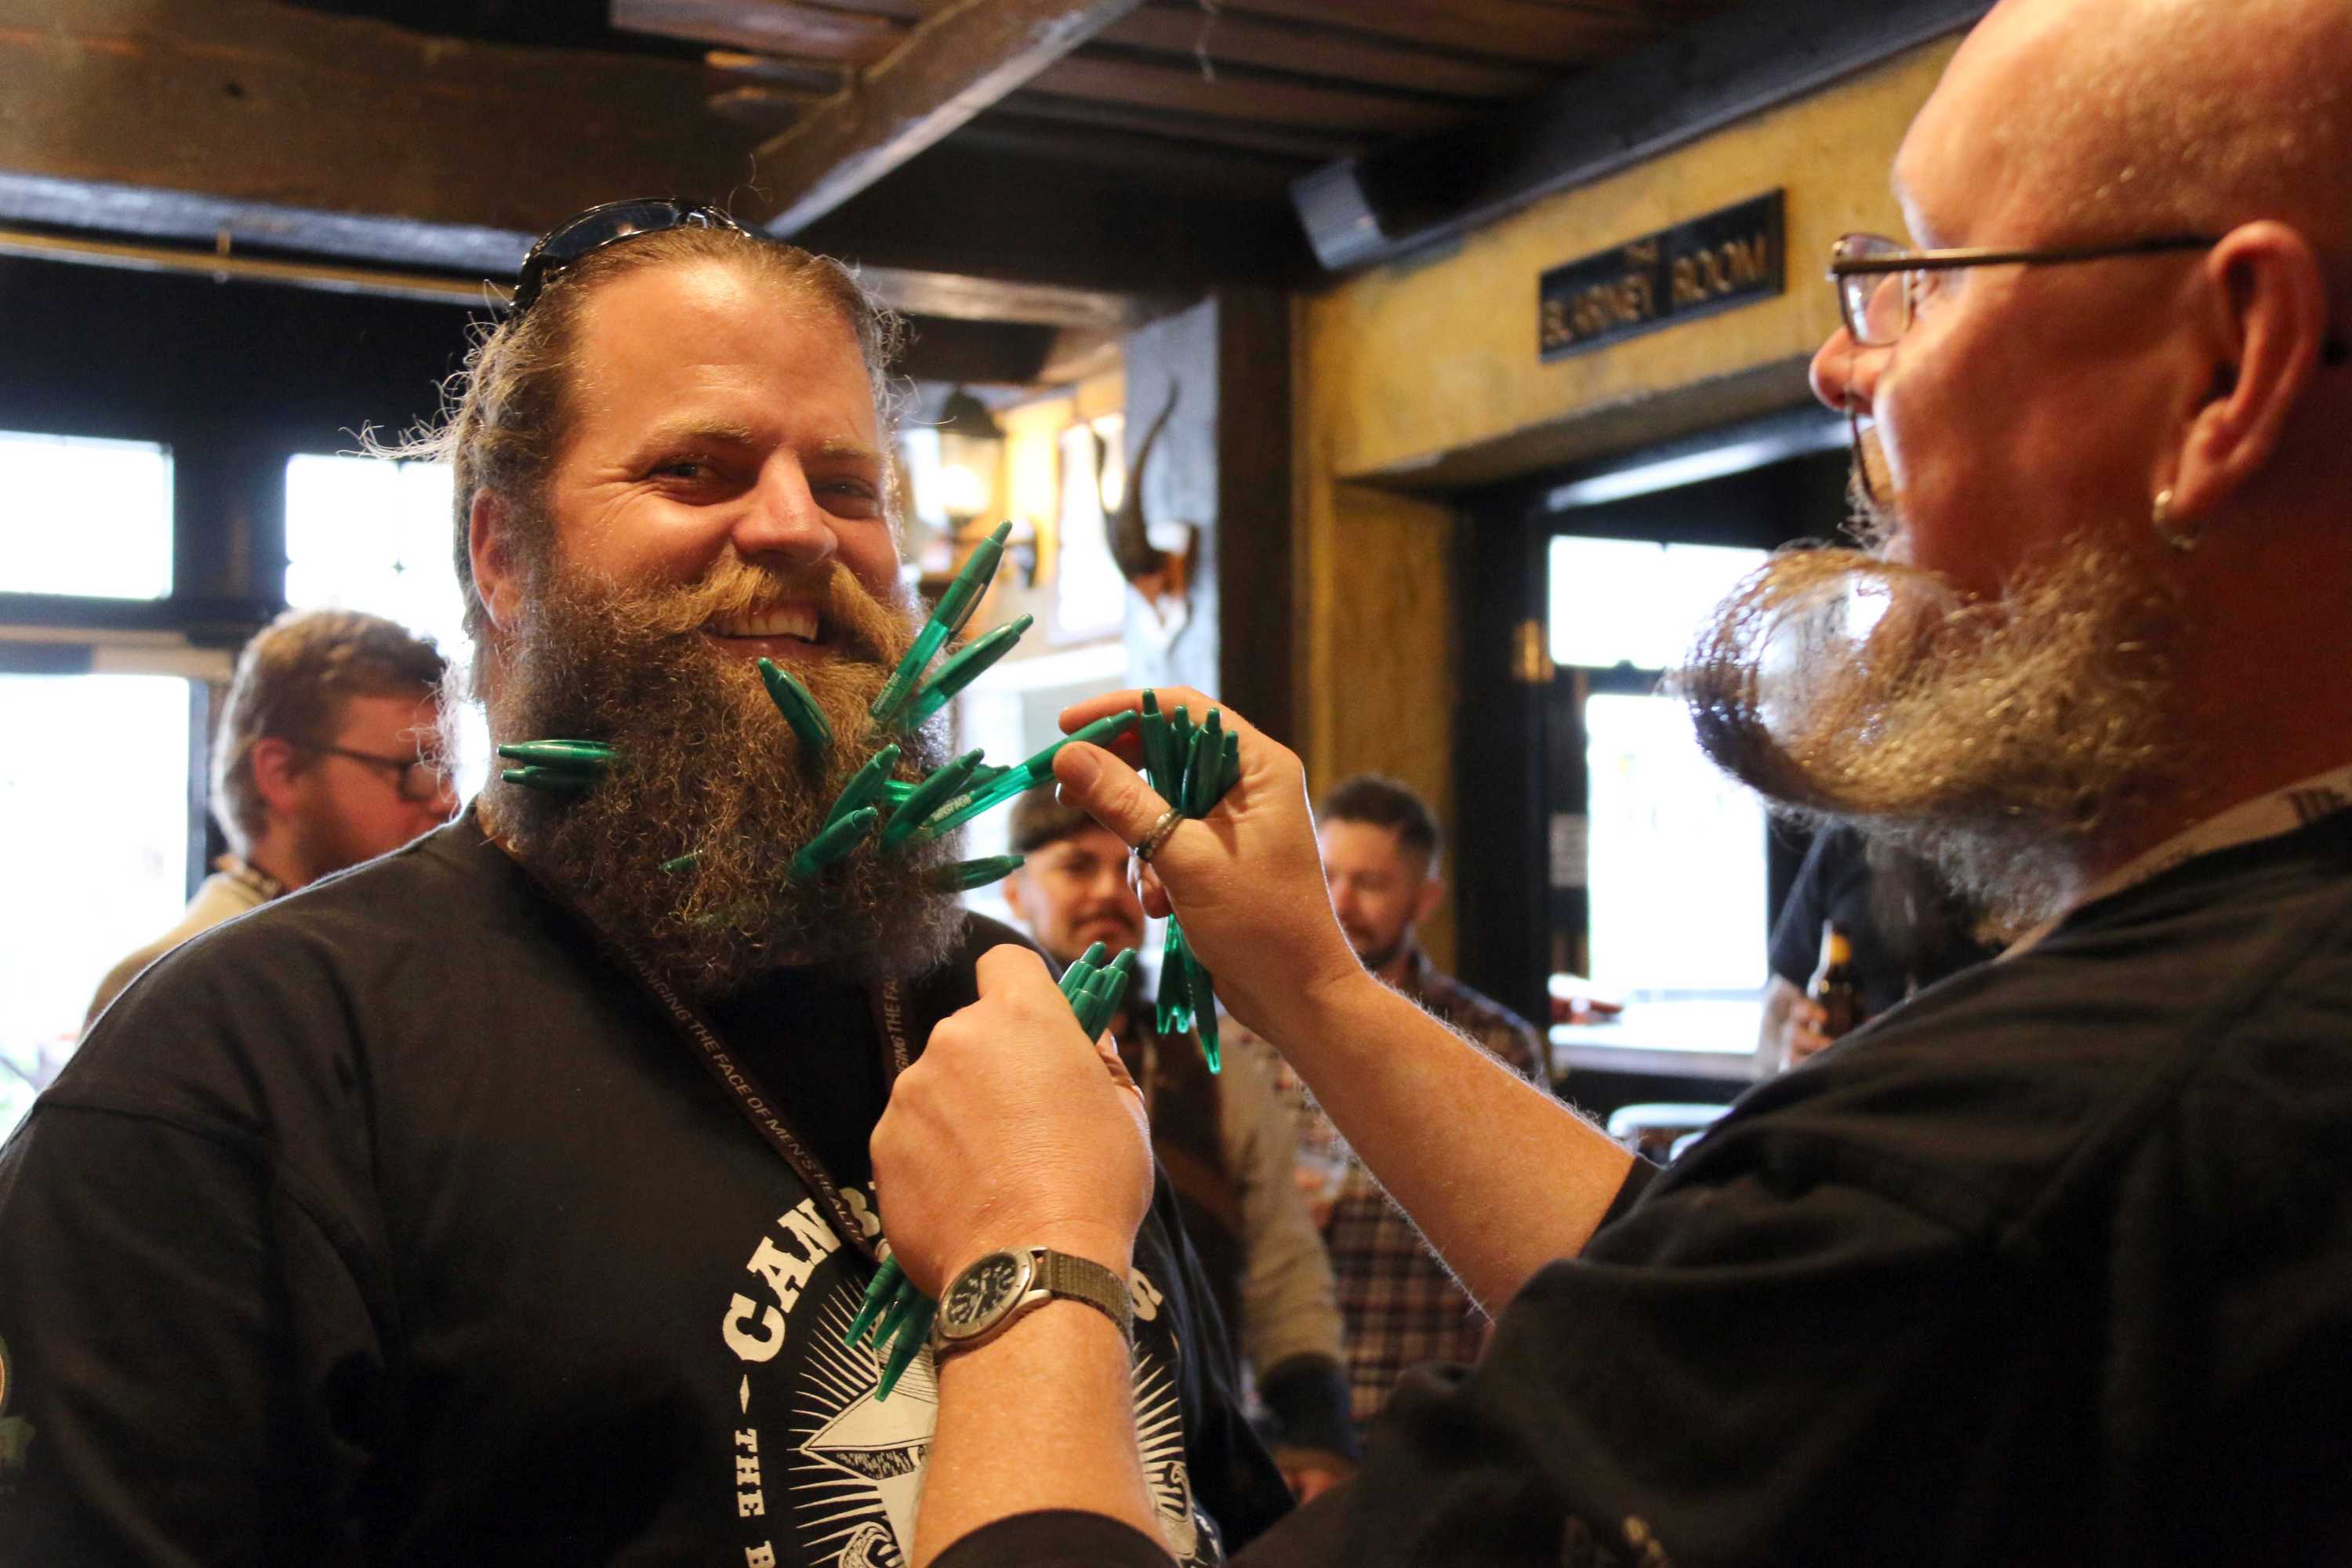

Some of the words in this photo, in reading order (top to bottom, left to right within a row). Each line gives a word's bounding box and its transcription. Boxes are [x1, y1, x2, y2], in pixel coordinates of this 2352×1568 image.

[1673, 232, 1768, 302] ROOM
[689, 1020, 720, 1053] THE
[713, 1053, 753, 1096] FACE
[746, 1098, 772, 1118] OF
[764, 1119, 816, 1171] MEN'S
[735, 1428, 766, 1518] THE
